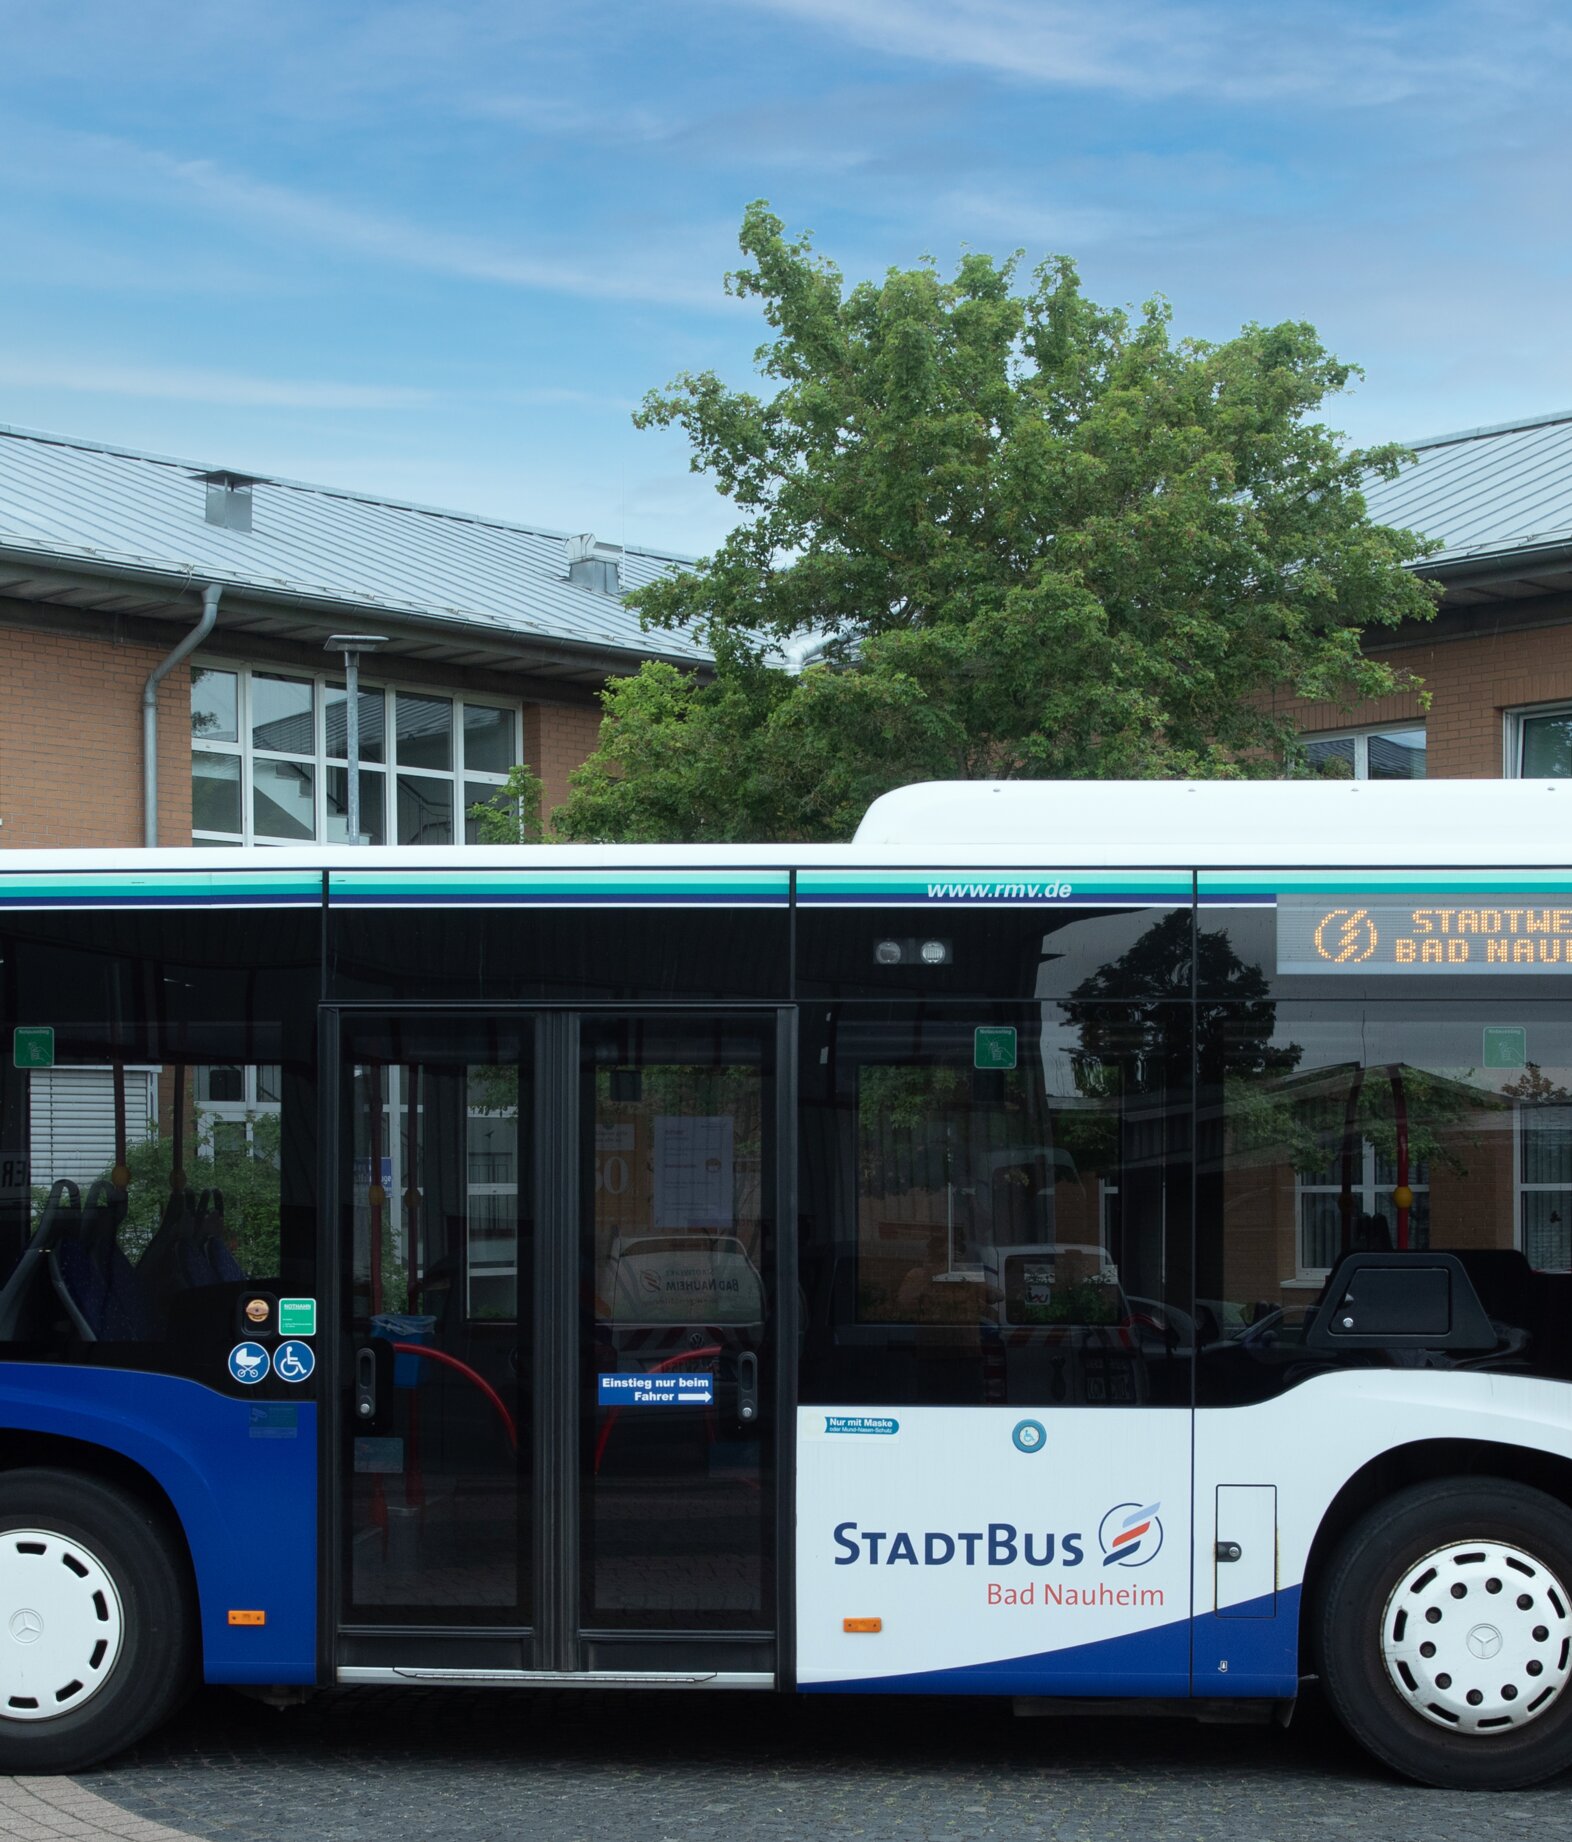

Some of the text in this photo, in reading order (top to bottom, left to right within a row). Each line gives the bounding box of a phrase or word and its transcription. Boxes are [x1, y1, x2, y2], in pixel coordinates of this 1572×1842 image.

[927, 880, 1073, 899] www.rmv.de
[1411, 909, 1572, 934] STADTWE
[1395, 938, 1469, 963] BAD
[602, 1377, 709, 1390] Einstieg nur beim
[634, 1391, 675, 1401] Fahrer
[829, 1418, 893, 1427] Nur mit Maske
[987, 1582, 1165, 1606] Bad Nauheim
